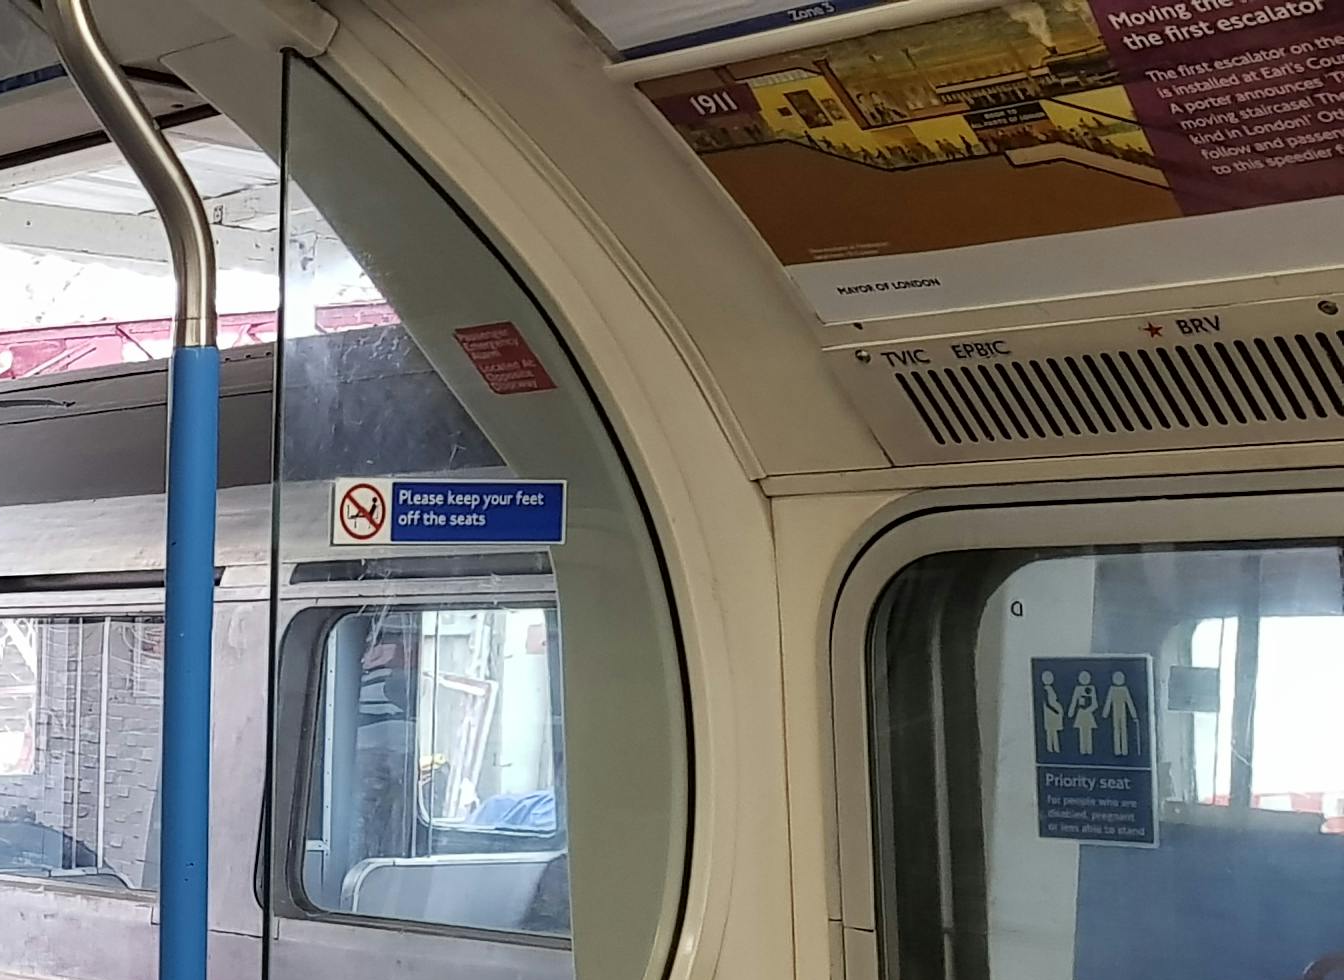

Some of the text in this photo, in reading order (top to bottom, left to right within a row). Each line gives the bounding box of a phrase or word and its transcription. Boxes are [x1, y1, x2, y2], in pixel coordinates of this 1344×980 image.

[787, 2, 835, 21] Zone 3
[1108, 0, 1234, 30] Moving the
[1123, 0, 1325, 51] the first escalator
[1145, 35, 1344, 84] The first escalator on the
[1157, 55, 1344, 99] is installed at Earl's Cou
[689, 90, 739, 116] 1911
[1170, 103, 1184, 115] A
[1184, 95, 1233, 114] porter
[1236, 78, 1324, 102] announces
[1180, 111, 1240, 130] moving
[1239, 97, 1315, 120] staircase!
[1189, 130, 1225, 145] kind
[1227, 128, 1244, 139] in
[1200, 145, 1251, 161] follow
[1253, 138, 1285, 152] and
[1212, 164, 1234, 176] to
[1233, 157, 1265, 172] this
[1266, 147, 1333, 170] speedier
[837, 278, 941, 296] MAYOR OF LONDON
[1175, 314, 1220, 335] BRV
[399, 489, 544, 511] Please keep your feet
[398, 511, 486, 526] off the seats
[1045, 773, 1132, 791] Priority seat
